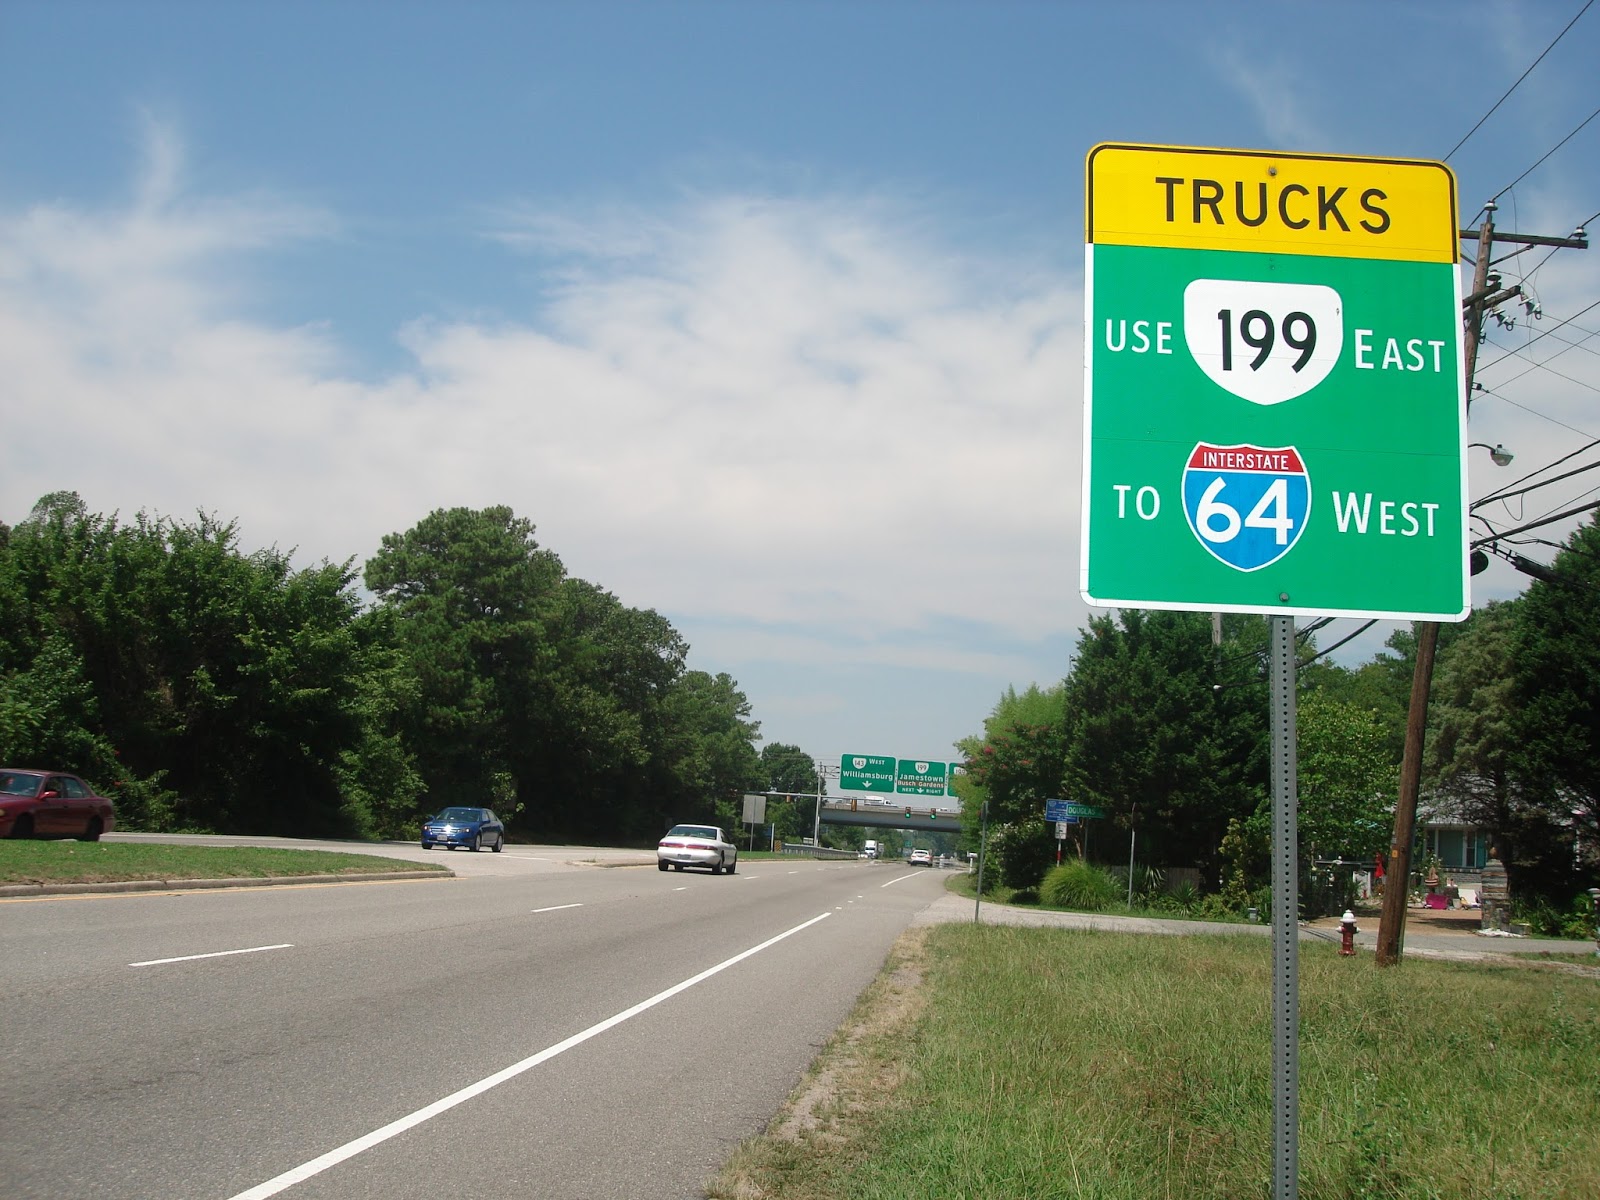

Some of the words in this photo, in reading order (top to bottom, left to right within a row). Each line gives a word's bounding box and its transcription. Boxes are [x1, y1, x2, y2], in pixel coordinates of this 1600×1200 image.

[1155, 176, 1391, 235] TRUCKS
[1105, 318, 1173, 355] USE
[1217, 308, 1317, 374] 199
[1354, 328, 1446, 373] EAST
[1202, 451, 1290, 471] INTERSTATE
[1113, 484, 1161, 521] TO
[1195, 476, 1294, 545] 64
[1331, 490, 1440, 537] WEST
[843, 770, 893, 781] Williamsburg
[899, 773, 943, 782] Jamestown
